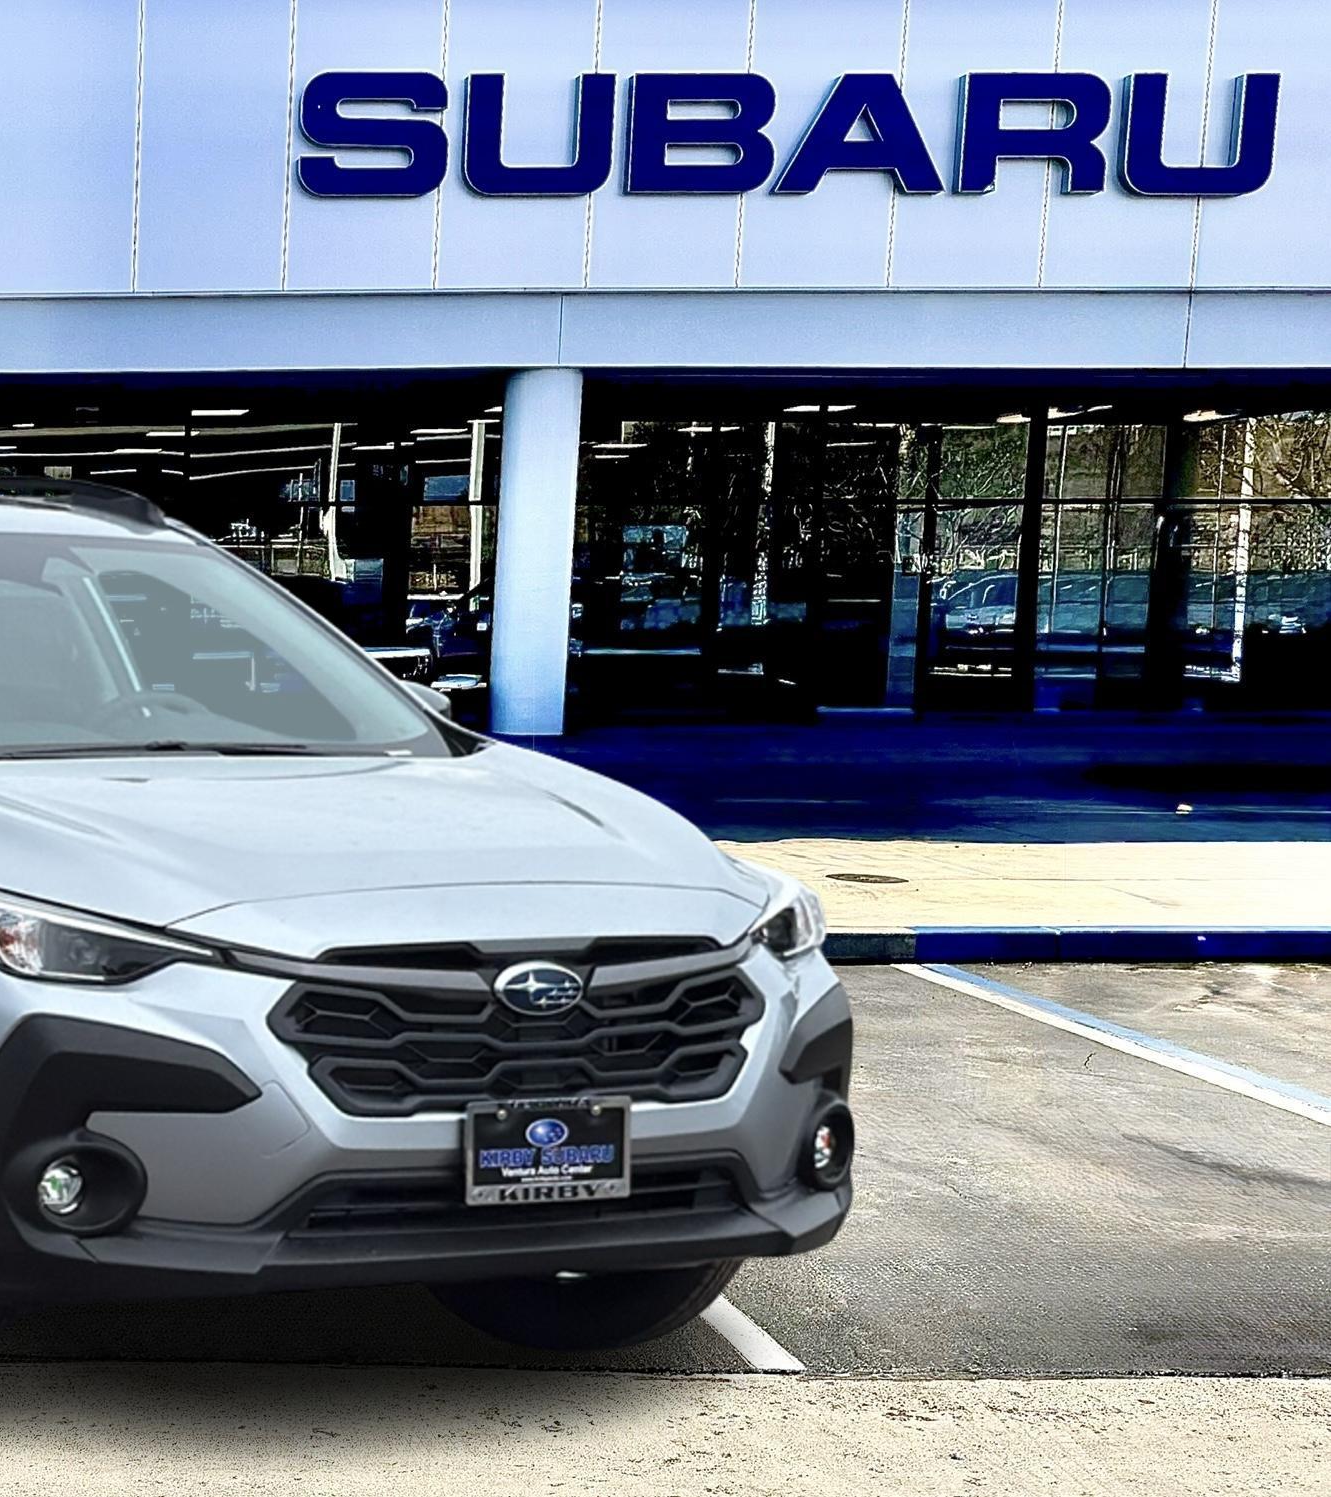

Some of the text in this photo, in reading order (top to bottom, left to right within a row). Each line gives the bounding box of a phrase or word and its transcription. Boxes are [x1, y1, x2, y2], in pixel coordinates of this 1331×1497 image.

[296, 71, 1282, 197] SUBARU
[479, 1145, 615, 1168] KIRBY SUBARU
[501, 1164, 593, 1177] Ventura Auto Center
[499, 1184, 600, 1201] KIRBY
